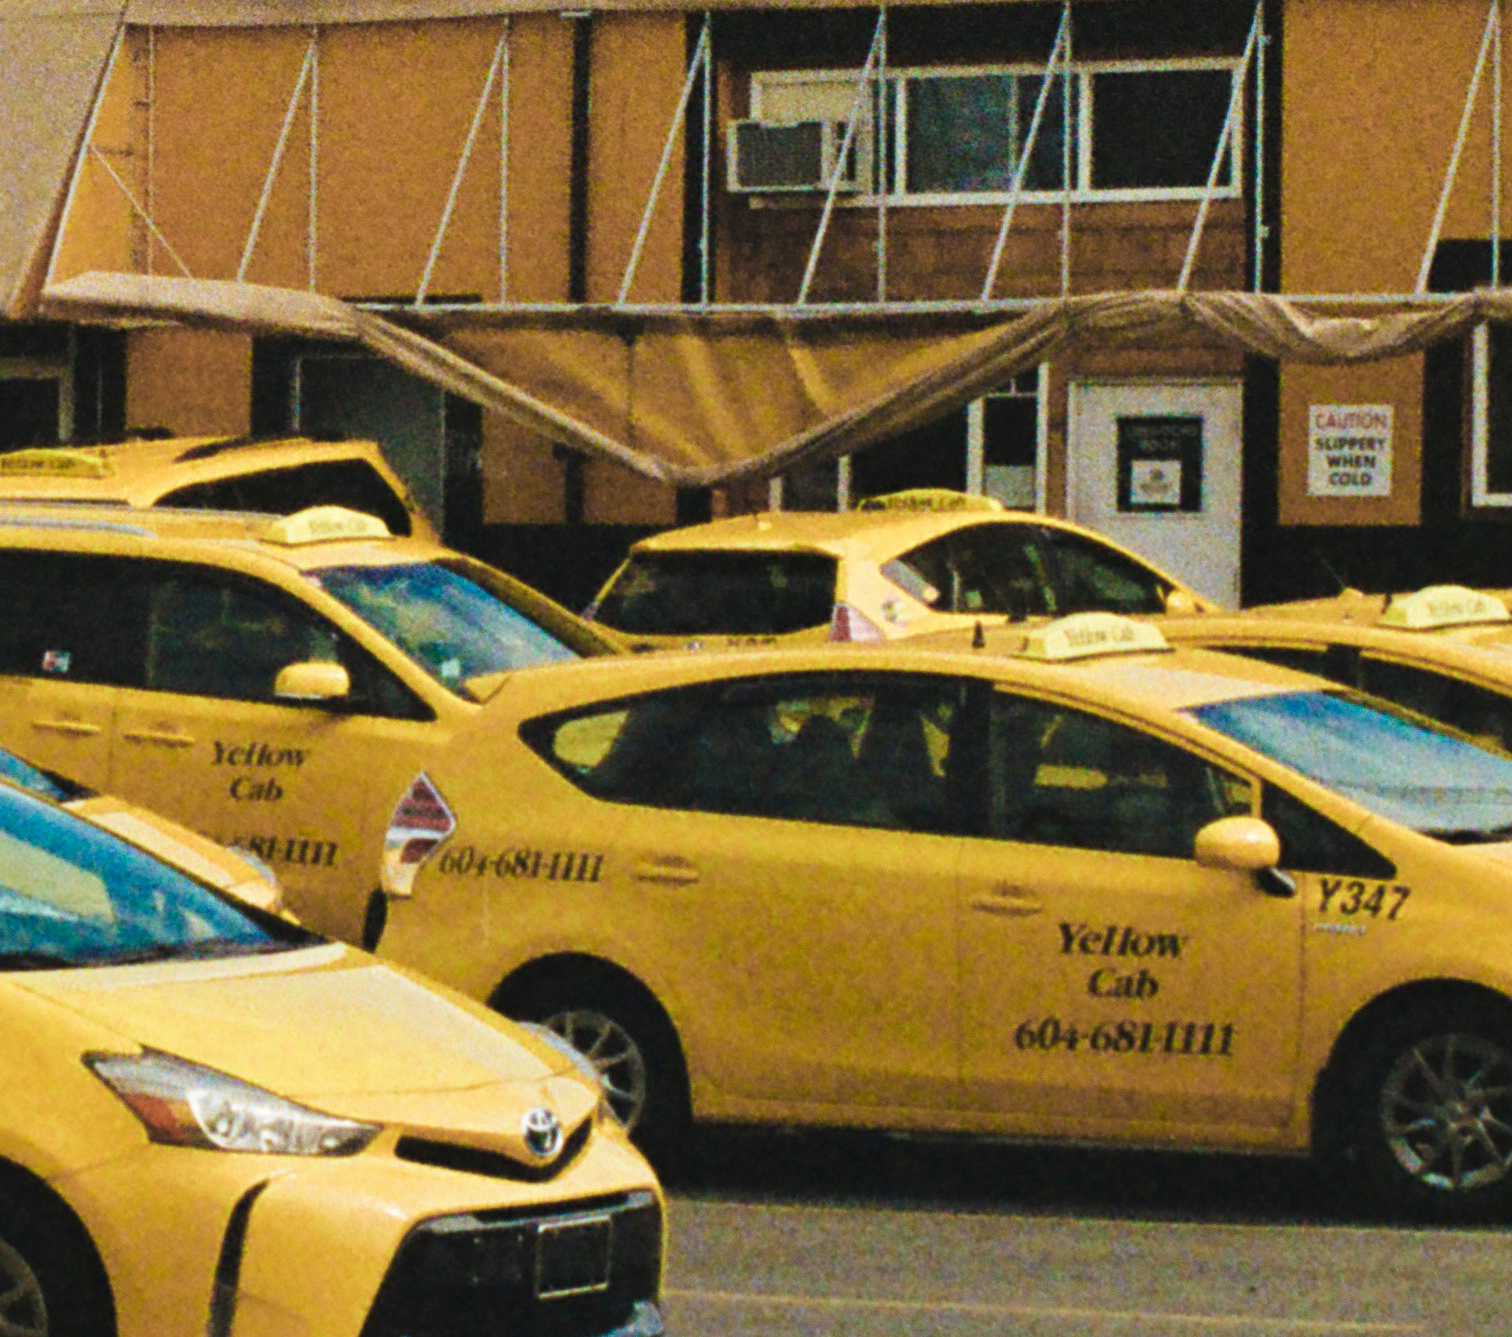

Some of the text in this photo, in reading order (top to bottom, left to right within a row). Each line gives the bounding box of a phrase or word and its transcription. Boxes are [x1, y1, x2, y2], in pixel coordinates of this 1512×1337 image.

[1315, 413, 1390, 429] CAUTION
[1315, 437, 1387, 452] SLIPPERY
[1328, 454, 1376, 468] WHEN
[1328, 472, 1373, 487] COLD
[212, 740, 310, 768] Yellow
[228, 777, 285, 802] Cab
[1318, 877, 1411, 920] Y347
[1058, 921, 1188, 959] Yellow
[1087, 967, 1160, 1000] Cab
